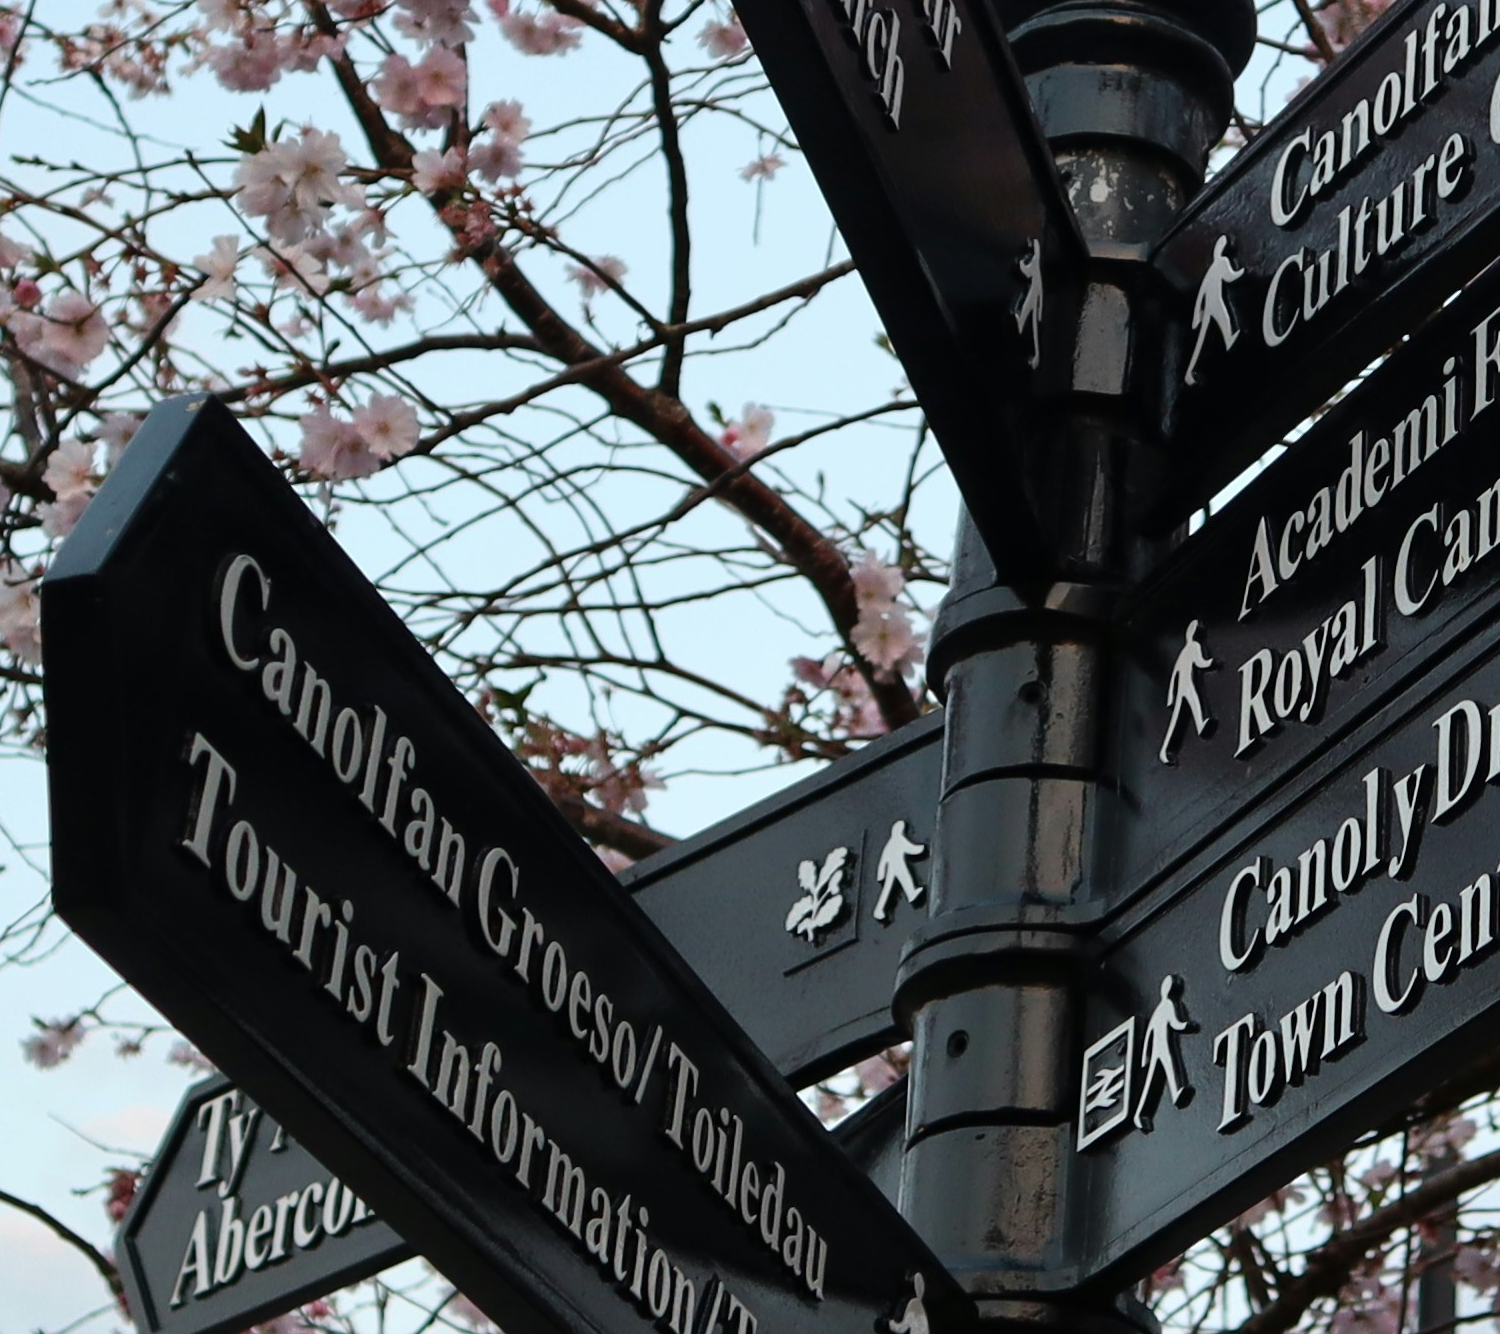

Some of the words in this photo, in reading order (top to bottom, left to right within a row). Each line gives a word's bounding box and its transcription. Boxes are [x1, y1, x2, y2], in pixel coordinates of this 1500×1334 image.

[1262, 131, 1466, 349] Culture
[1237, 365, 1459, 622] Academi
[219, 554, 465, 908] Canolfan
[1233, 555, 1380, 758] Royal
[182, 731, 399, 1046] Tourist
[1213, 970, 1373, 1133] Town
[169, 1177, 376, 1307] Aberco
